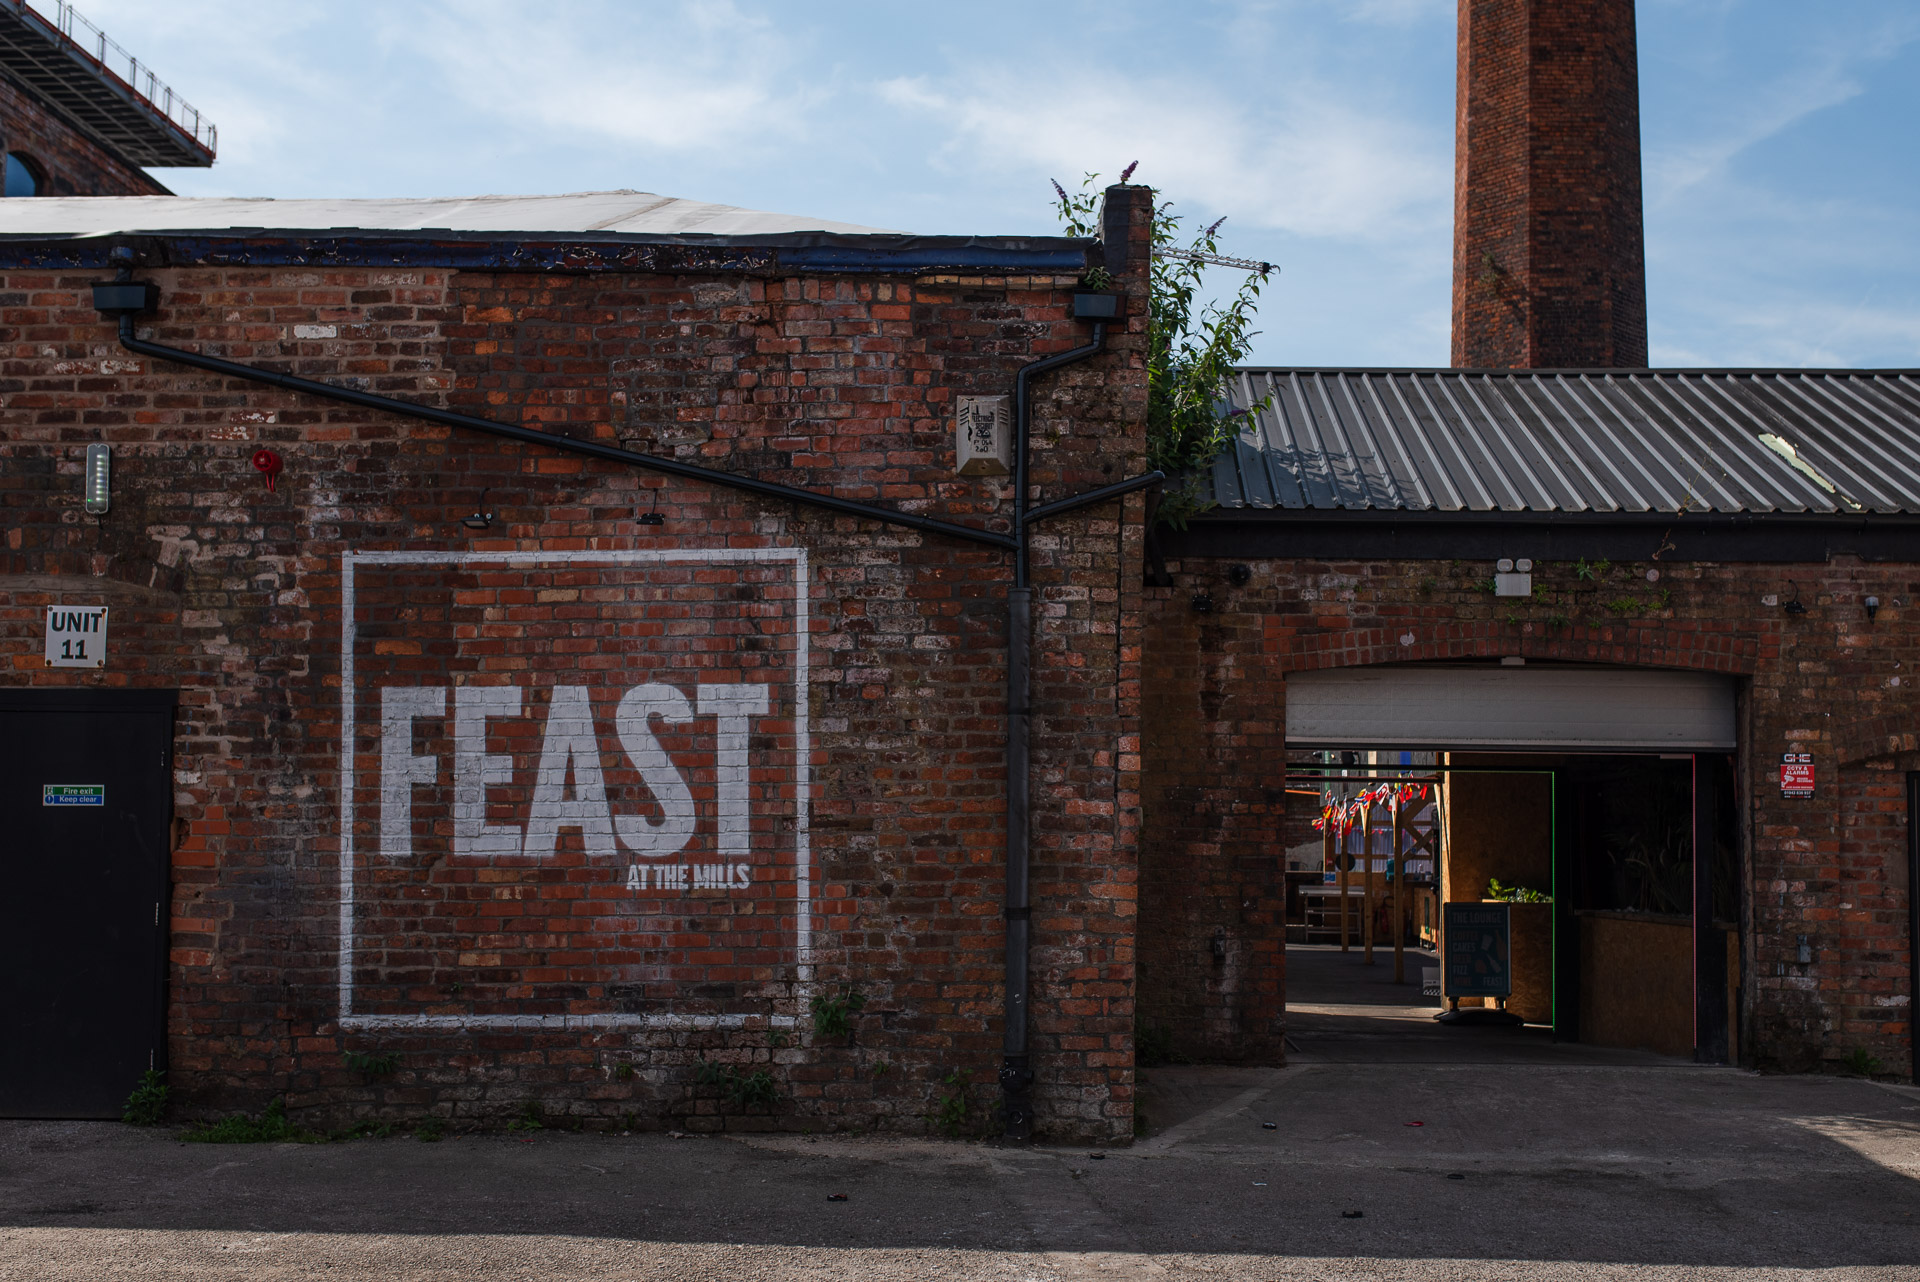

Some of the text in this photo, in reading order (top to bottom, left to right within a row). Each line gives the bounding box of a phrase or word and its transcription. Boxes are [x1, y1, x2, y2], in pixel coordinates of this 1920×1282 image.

[52, 612, 102, 632] UNIT
[61, 639, 88, 659] 11
[1784, 754, 1810, 762] GHE
[380, 683, 769, 857] FEAST
[626, 863, 750, 890] AT THE MILLS
[1452, 911, 1503, 924] THE LOUNGE
[1452, 942, 1476, 953] CAKES
[1452, 965, 1468, 976] FIZZ
[1483, 977, 1503, 987] FEAST
